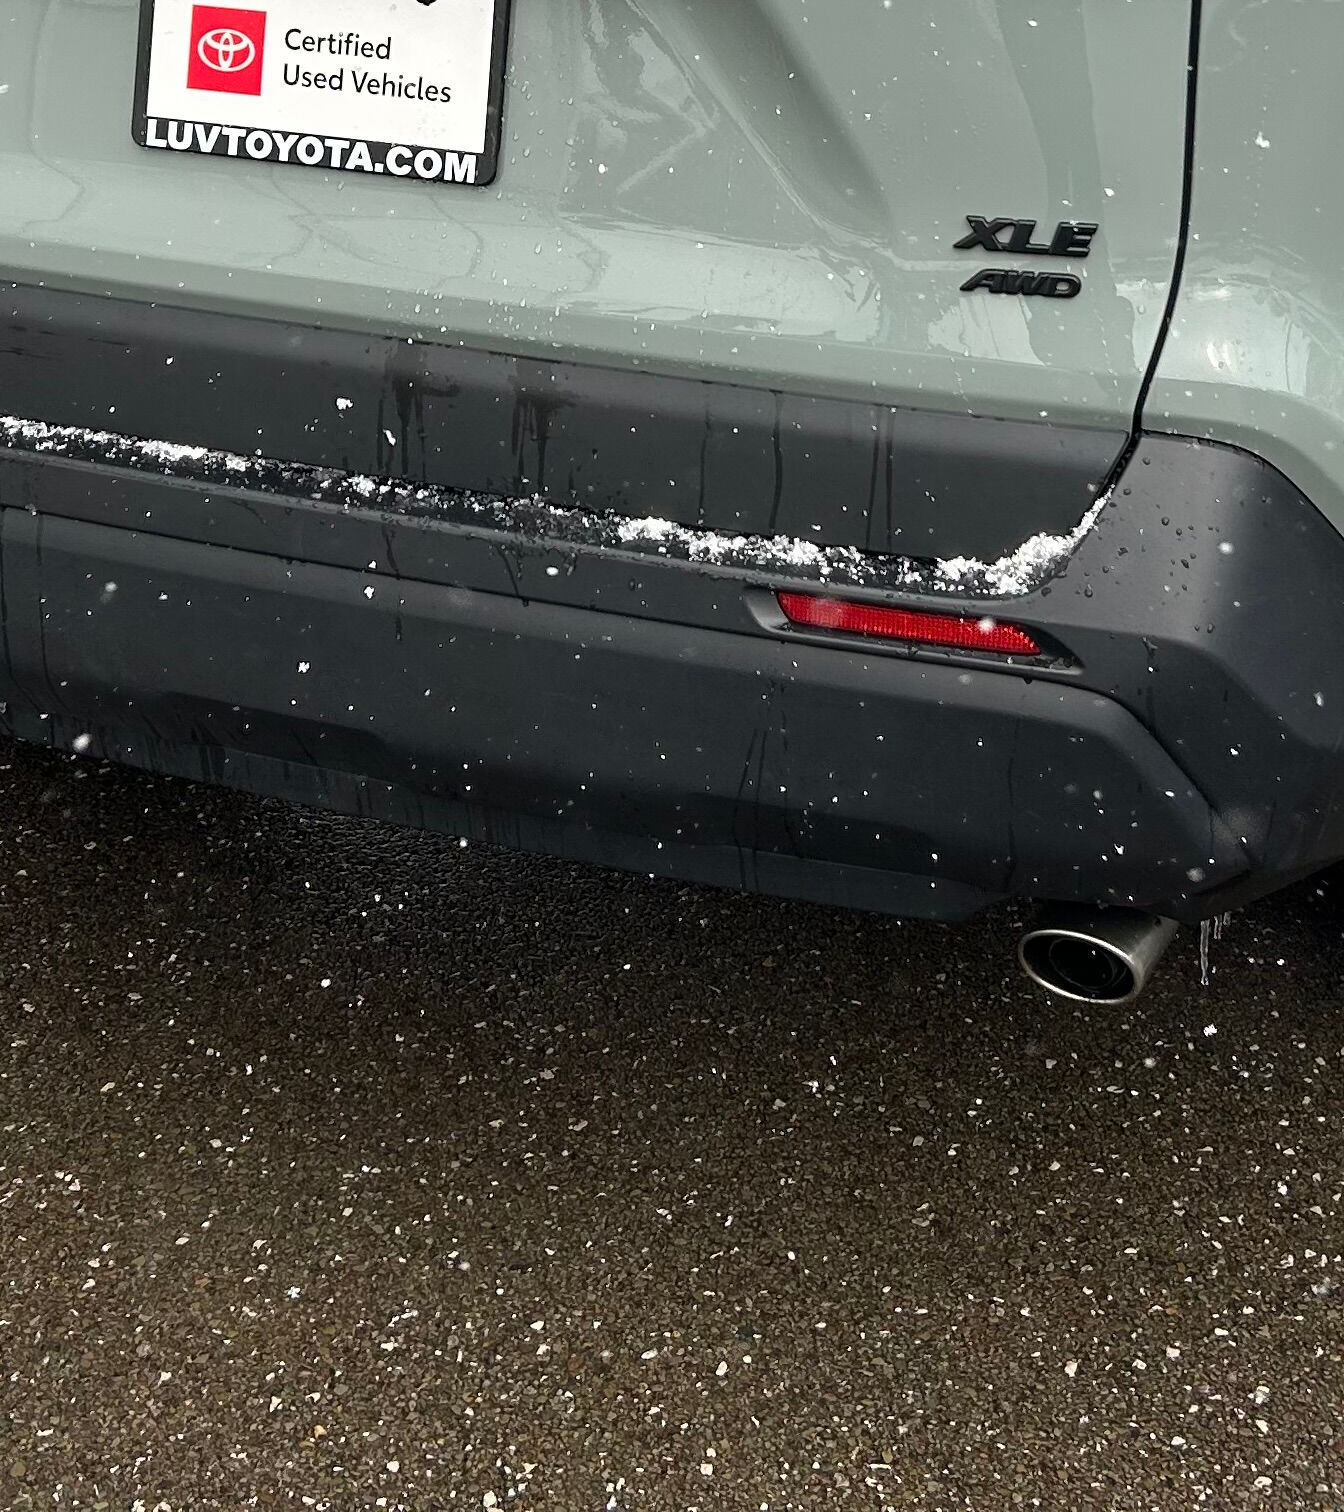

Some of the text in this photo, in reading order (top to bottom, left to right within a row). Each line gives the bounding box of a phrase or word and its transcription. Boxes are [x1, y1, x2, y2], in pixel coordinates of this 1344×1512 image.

[284, 28, 392, 60] Certified
[282, 63, 453, 103] Used Vehicles
[144, 118, 477, 184] LUVTOYOTA.COM
[953, 214, 1099, 257] XLE
[959, 268, 1082, 298] AWD
